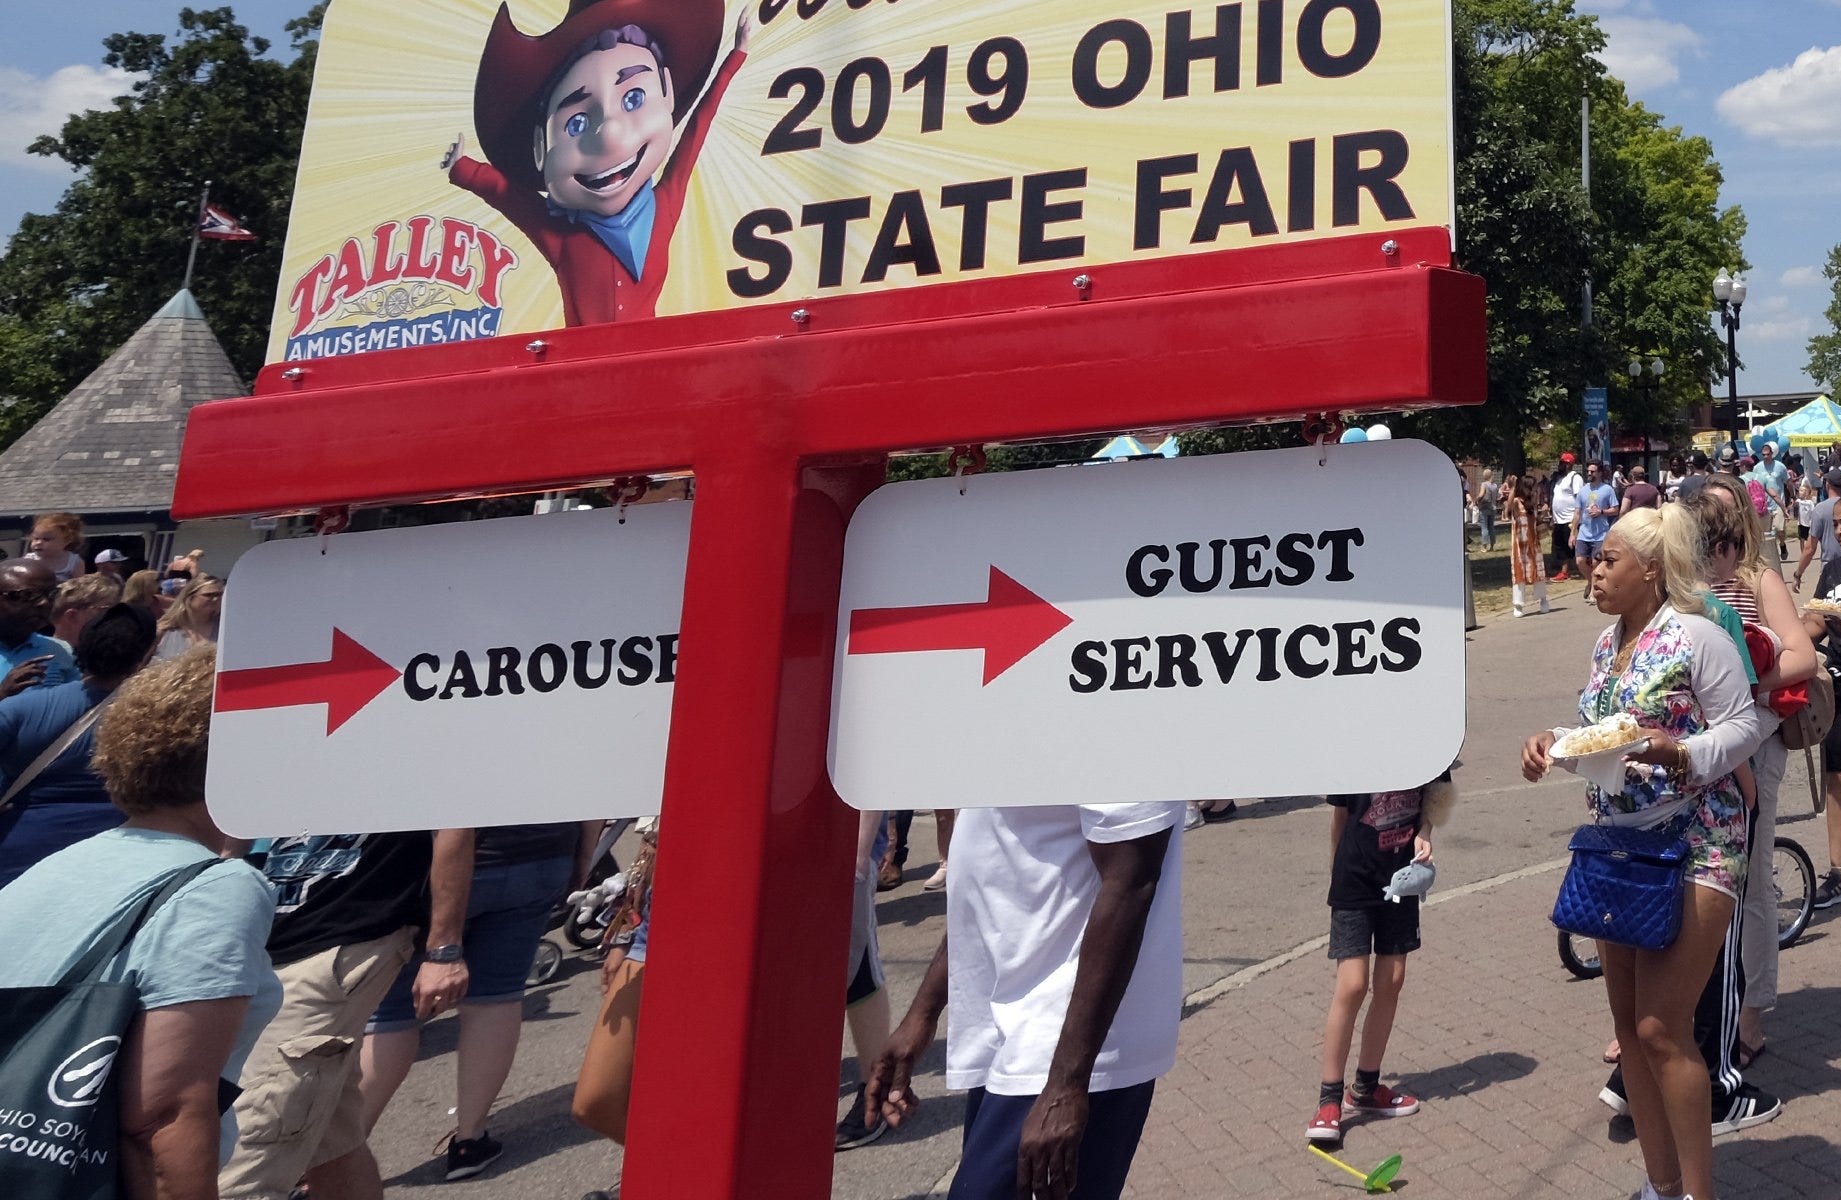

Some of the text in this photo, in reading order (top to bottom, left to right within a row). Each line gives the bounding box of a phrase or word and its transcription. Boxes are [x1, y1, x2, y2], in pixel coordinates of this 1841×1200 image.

[760, 35, 1029, 157] 2019
[726, 129, 1417, 298] STATE FAIR
[290, 215, 518, 339] TALLEY
[1125, 527, 1364, 598] GUEST
[403, 633, 681, 701] CAROUSE
[1069, 617, 1422, 693] SERVICES
[0, 1109, 36, 1128] HIO
